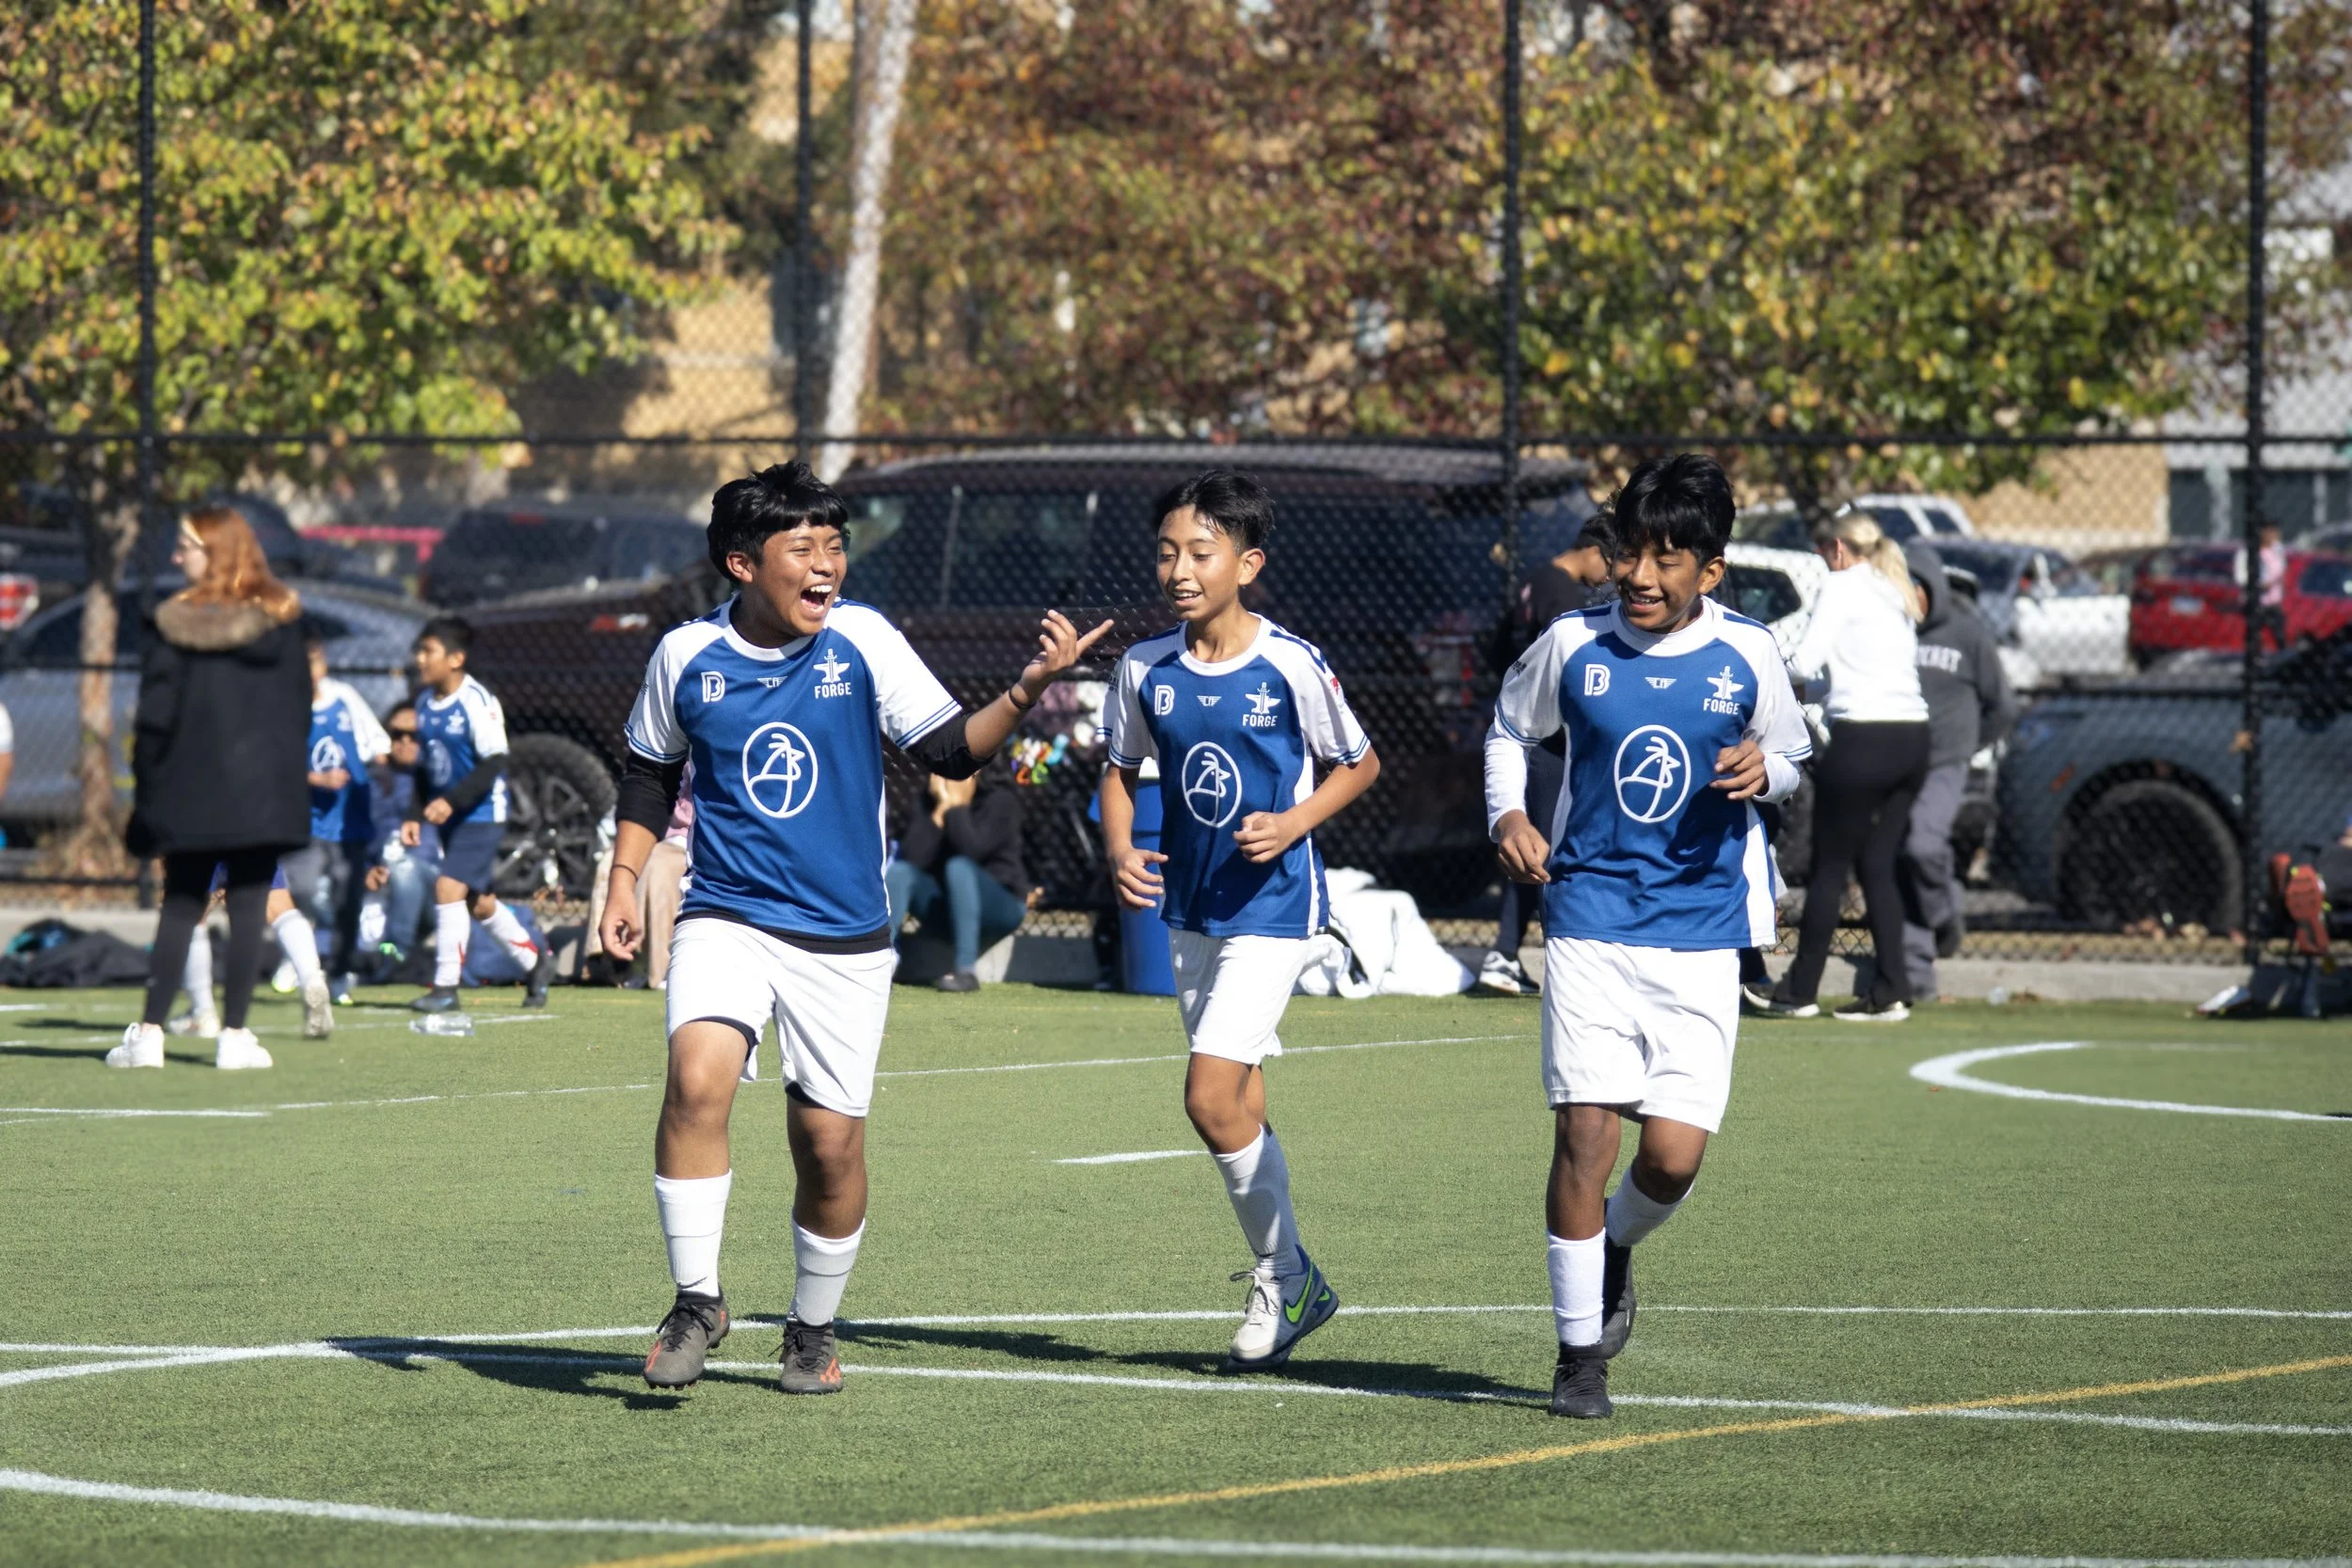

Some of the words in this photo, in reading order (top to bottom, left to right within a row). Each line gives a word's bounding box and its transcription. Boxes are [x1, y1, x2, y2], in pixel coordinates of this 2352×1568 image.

[814, 682, 851, 699] FORGE
[1703, 698, 1740, 715] FORGE
[1242, 714, 1278, 727] FORGE
